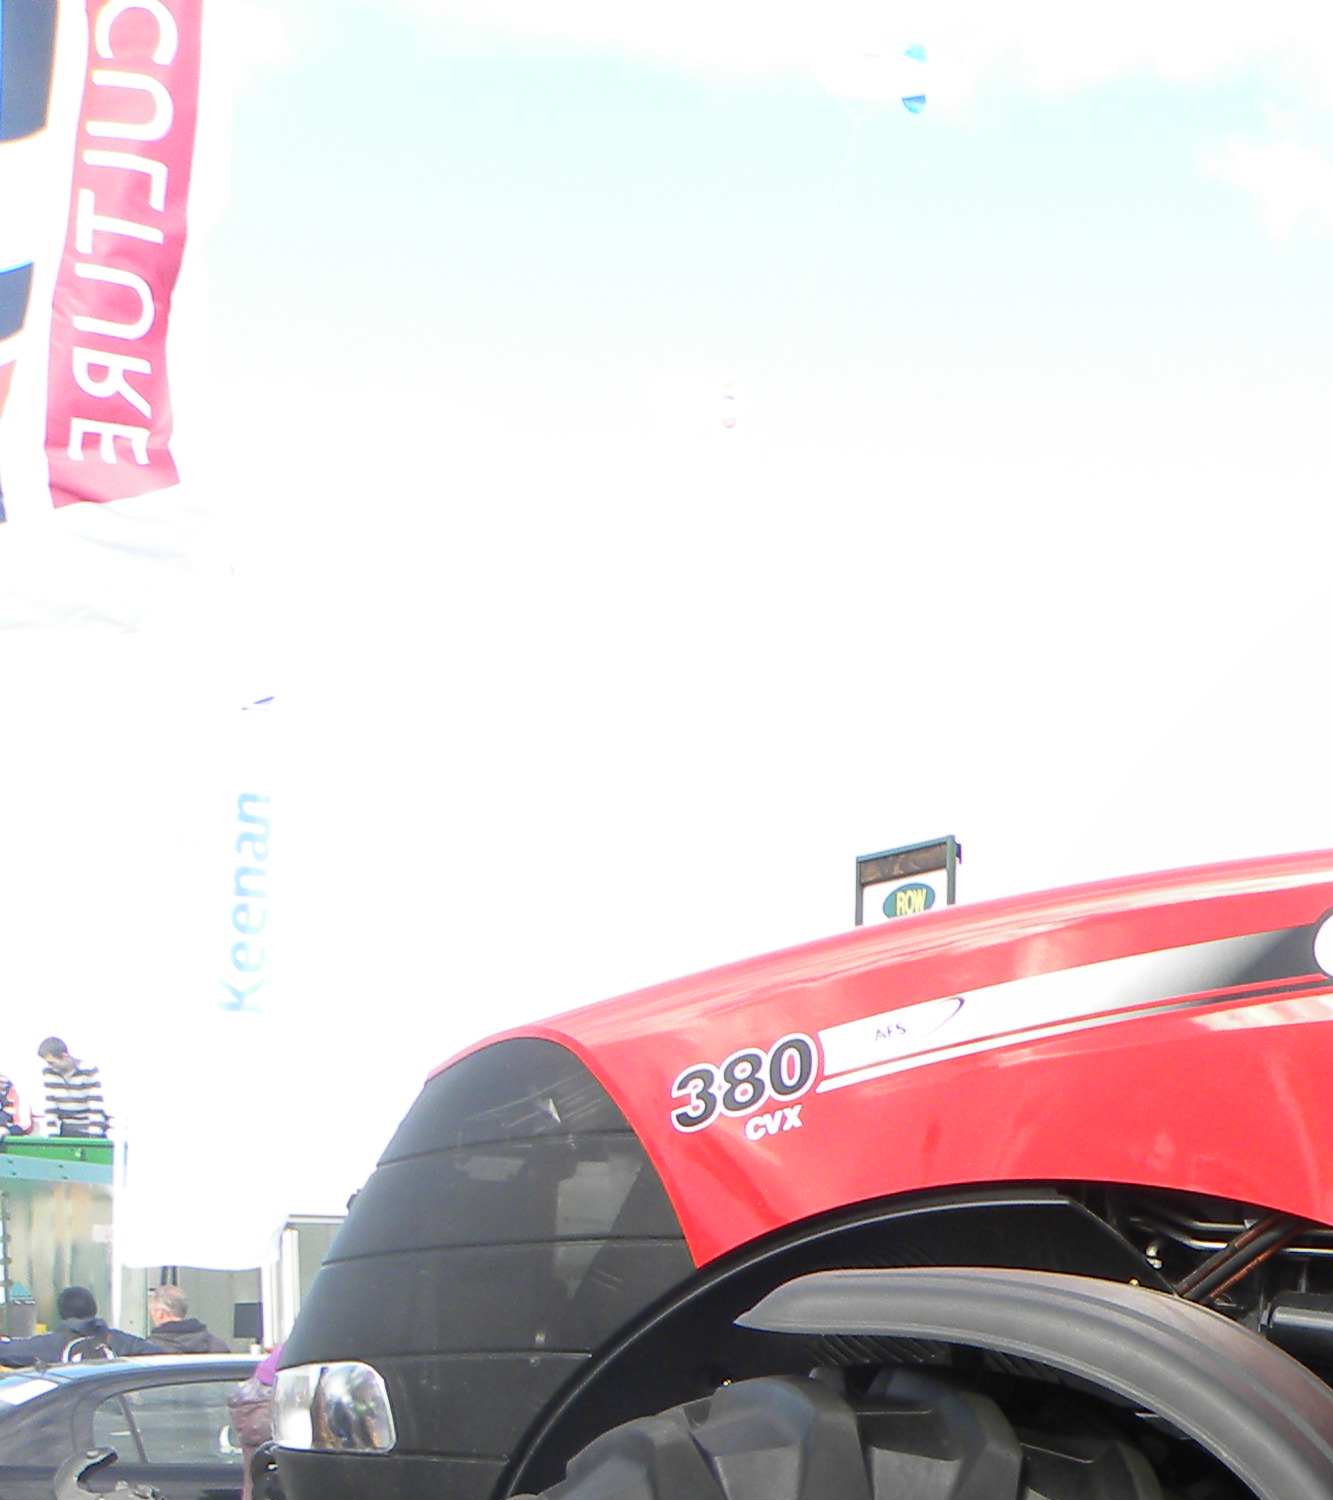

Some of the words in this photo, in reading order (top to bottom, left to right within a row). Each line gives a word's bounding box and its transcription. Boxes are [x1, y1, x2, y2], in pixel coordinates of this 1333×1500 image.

[895, 888, 927, 916] ROW
[875, 1021, 907, 1042] AFS
[671, 1032, 817, 1132] 380
[745, 1104, 803, 1140] CVX
